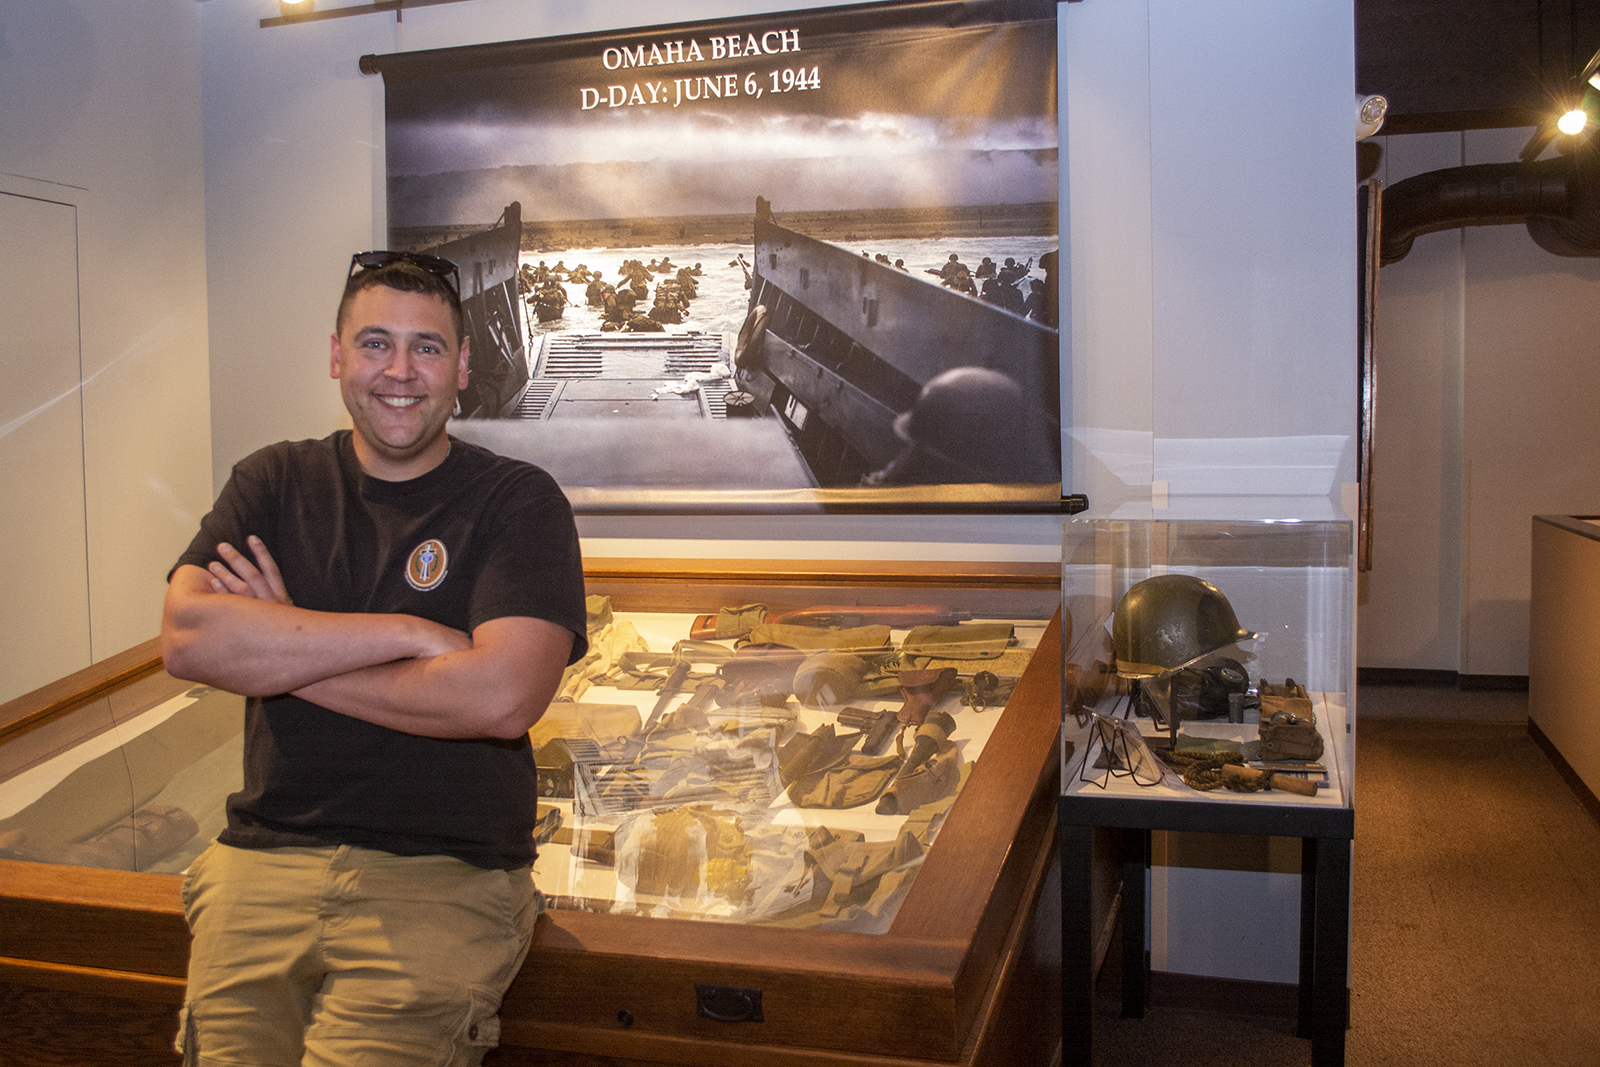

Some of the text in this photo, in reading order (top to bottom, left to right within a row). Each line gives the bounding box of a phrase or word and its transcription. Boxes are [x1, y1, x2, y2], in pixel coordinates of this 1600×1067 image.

[602, 28, 802, 70] OMAHA BEACH
[580, 66, 821, 111] D-DAY: JUNE 6, 1944
